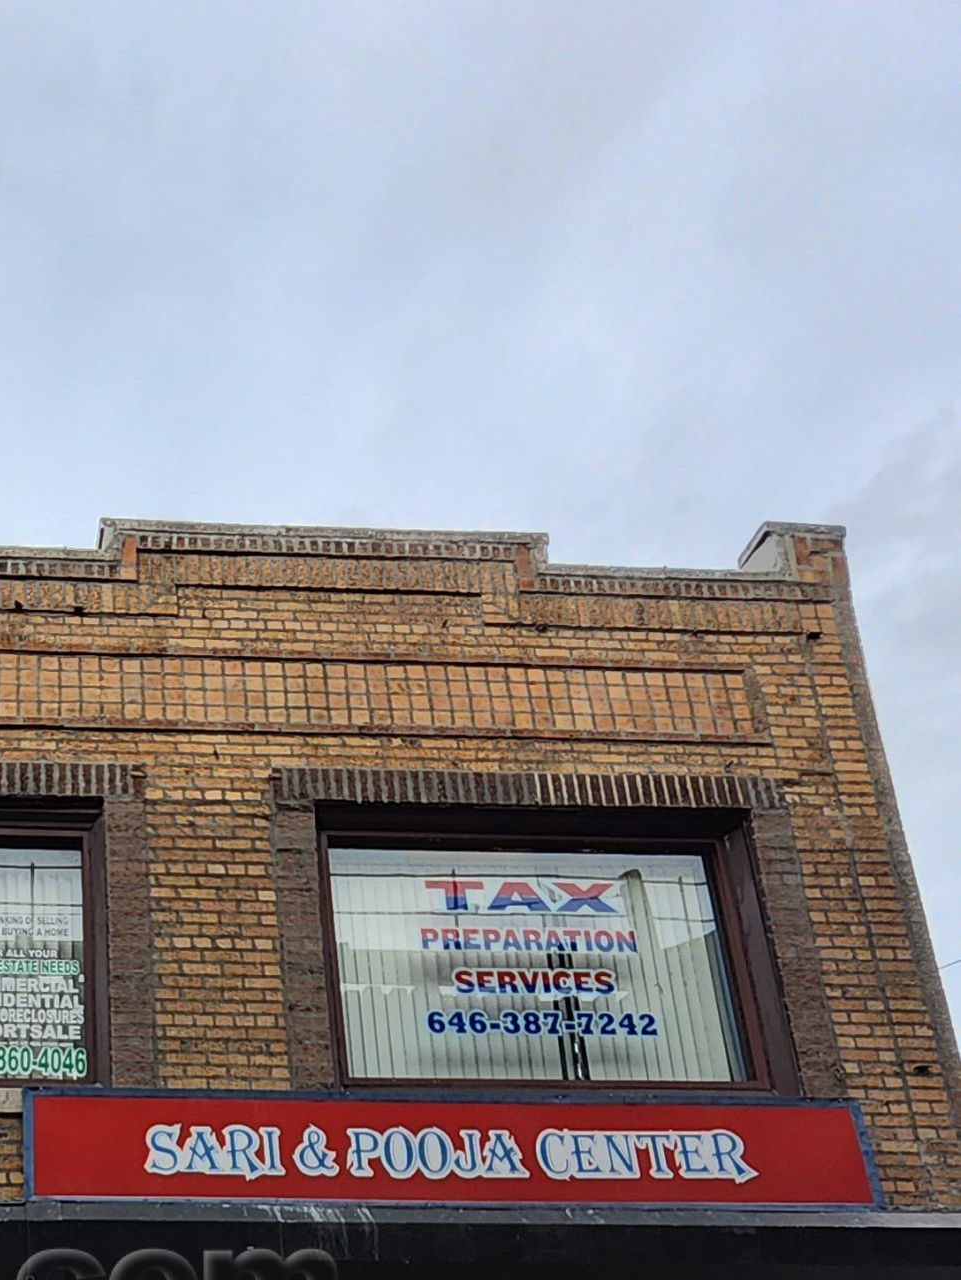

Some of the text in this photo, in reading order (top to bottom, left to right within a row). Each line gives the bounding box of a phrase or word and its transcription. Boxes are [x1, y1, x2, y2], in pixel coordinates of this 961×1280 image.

[425, 880, 619, 914] TAX
[421, 928, 638, 953] PREPARATION
[6, 949, 25, 957] ALL
[28, 949, 58, 958] YOUR
[41, 960, 79, 974] NEEDS
[454, 970, 615, 995] SERVICES
[427, 1010, 658, 1036] 646-387-7242
[145, 1125, 759, 1182] SARI & POOJA CENTER
